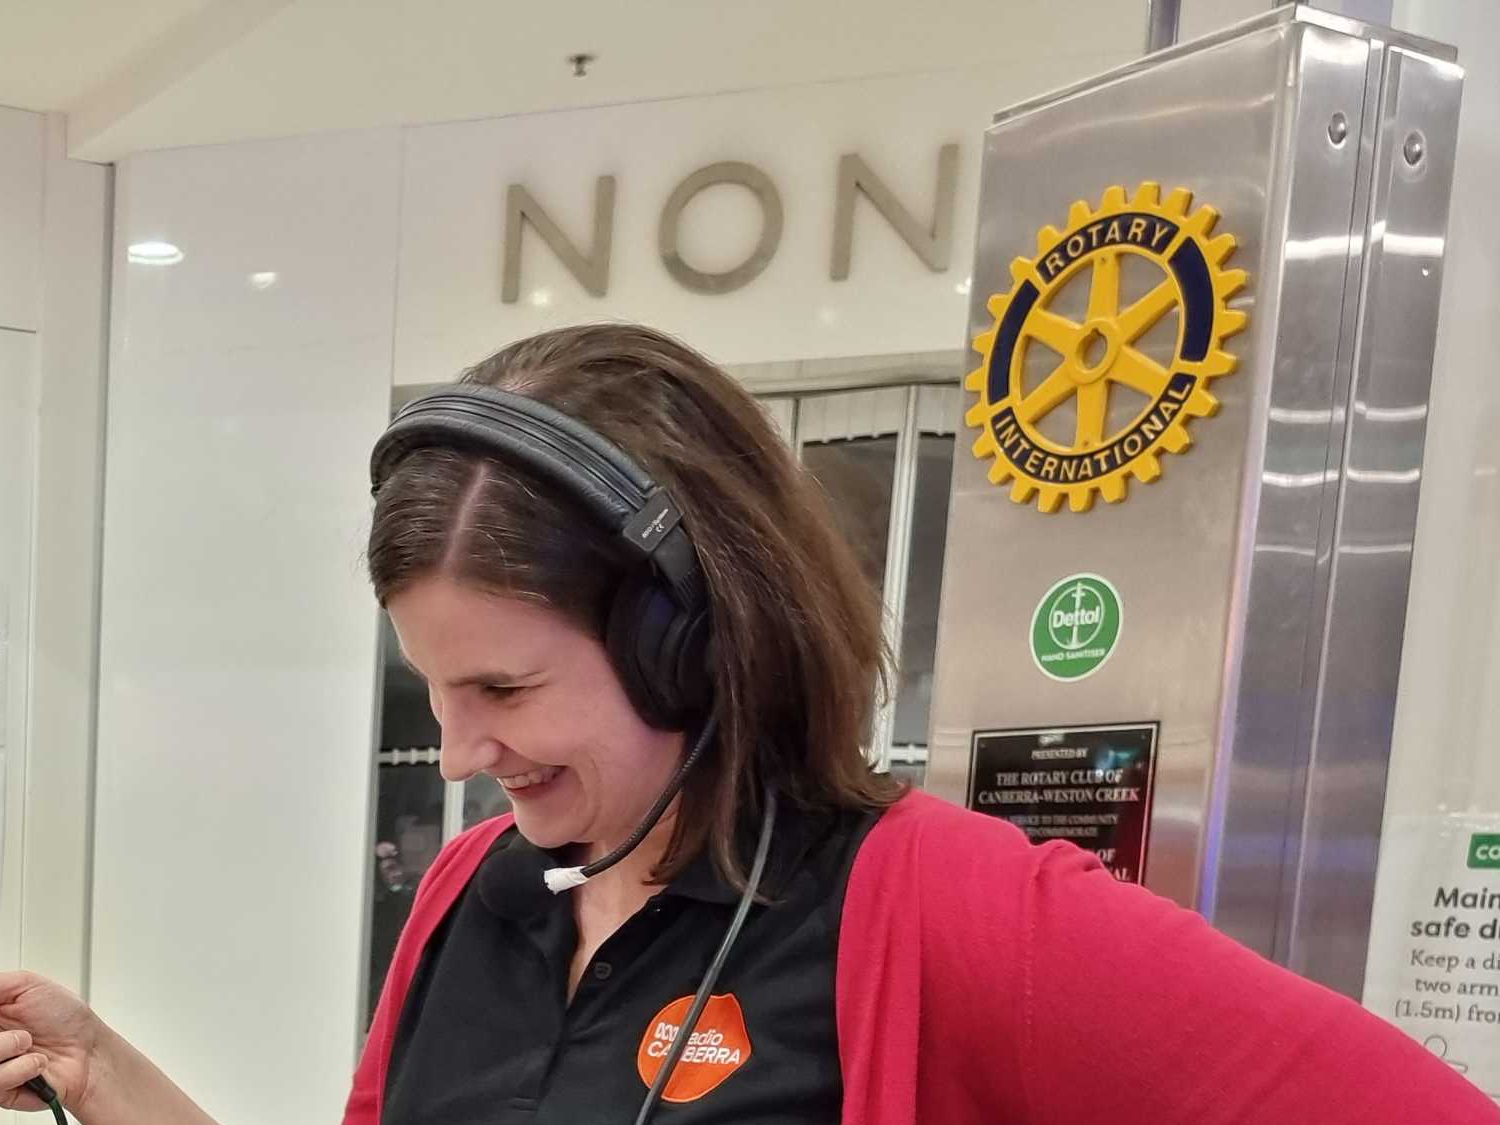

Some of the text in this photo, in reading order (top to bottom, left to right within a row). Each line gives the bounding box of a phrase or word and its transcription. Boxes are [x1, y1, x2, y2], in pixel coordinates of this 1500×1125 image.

[501, 143, 960, 304] NON
[1045, 217, 1169, 277] ROTARY
[995, 381, 1192, 482] INTERNATIONAL
[1053, 605, 1100, 628] Dettol
[996, 768, 1124, 786] THE ROTARY CLUB OF
[1095, 787, 1140, 802] CREEK
[1411, 917, 1470, 938] safe
[1411, 949, 1459, 973] Keep
[1465, 957, 1476, 969] a
[1415, 979, 1451, 993] two
[1395, 999, 1500, 1024] (1.5m) fro
[687, 1029, 725, 1046] adio
[647, 1041, 741, 1065] CABERRA
